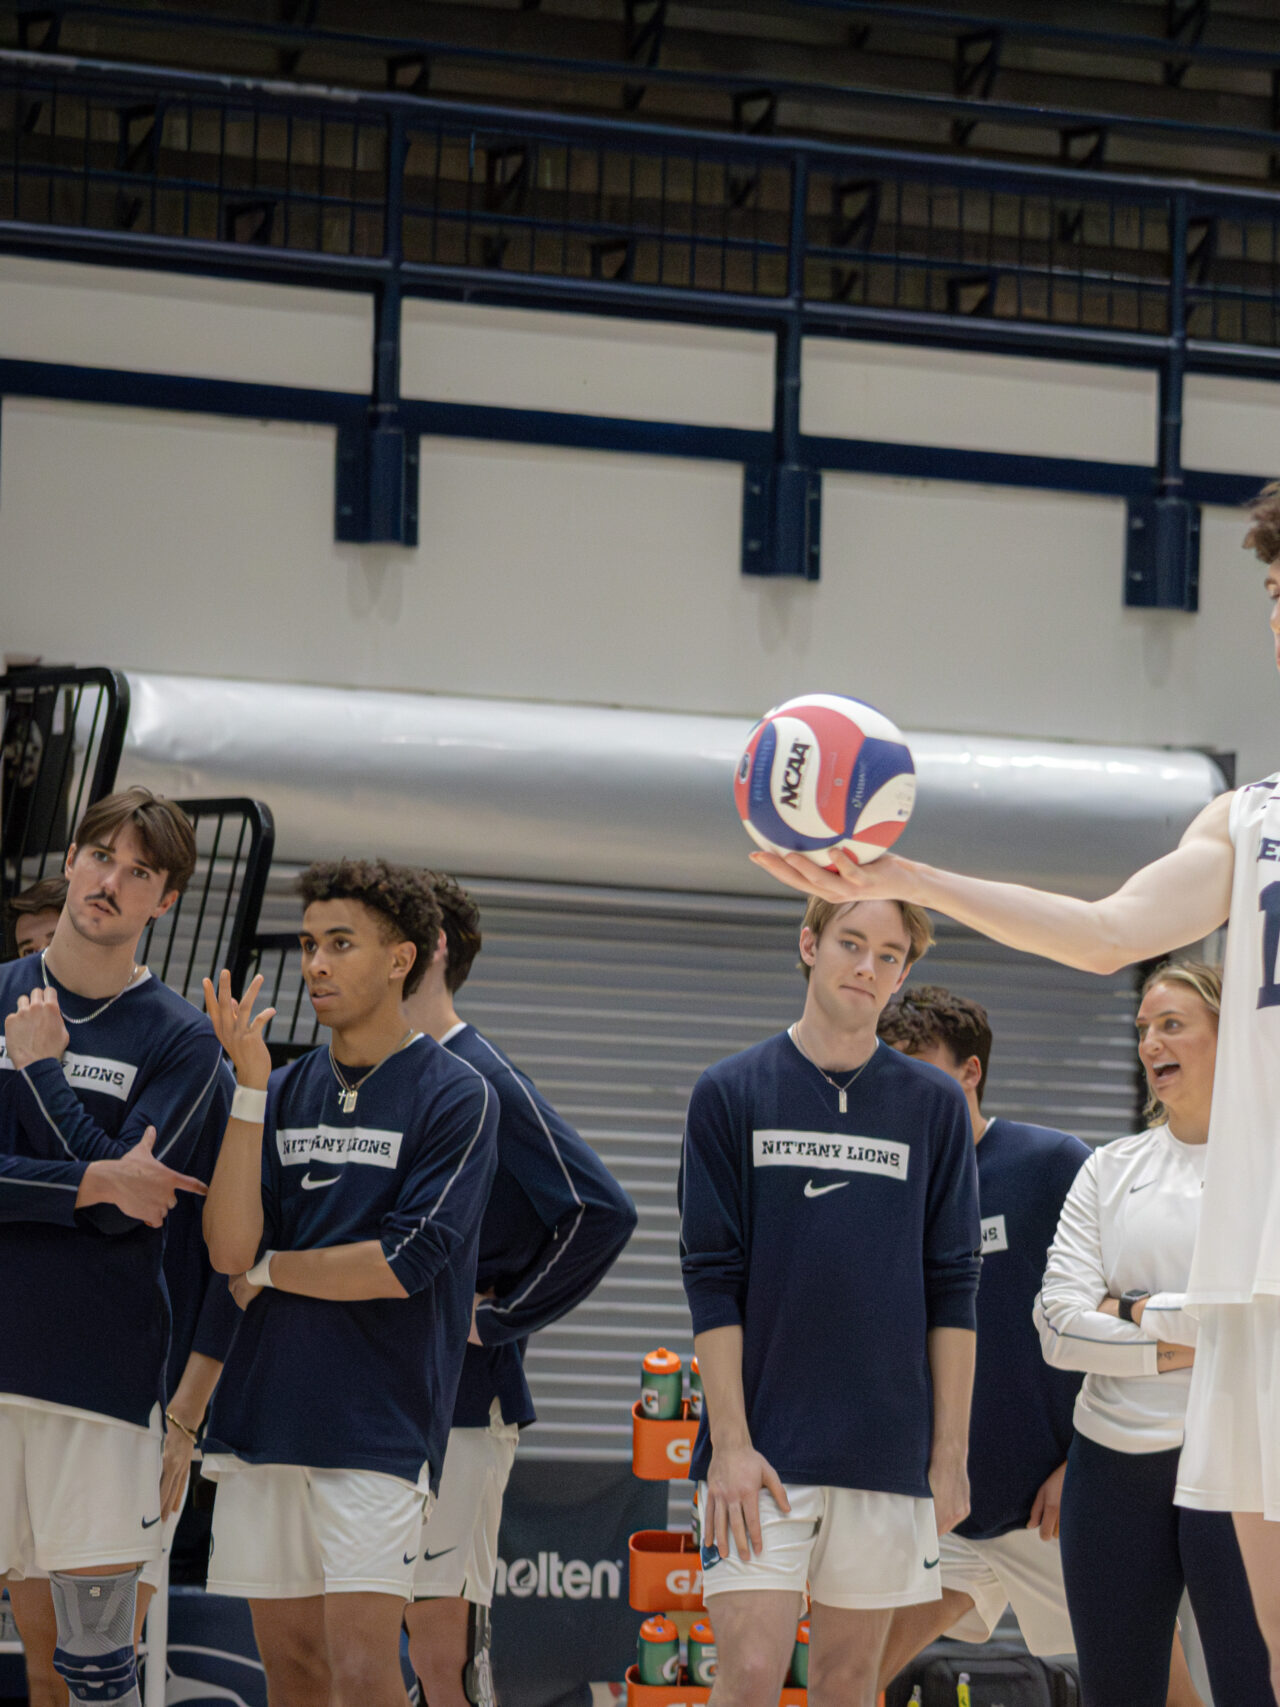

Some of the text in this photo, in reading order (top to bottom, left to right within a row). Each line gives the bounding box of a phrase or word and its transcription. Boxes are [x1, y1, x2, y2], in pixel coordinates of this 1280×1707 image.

[780, 743, 812, 809] NCAA
[71, 1063, 125, 1086] LIONS
[762, 1140, 900, 1167] NITTANY LIONS
[496, 1551, 620, 1599] olten
